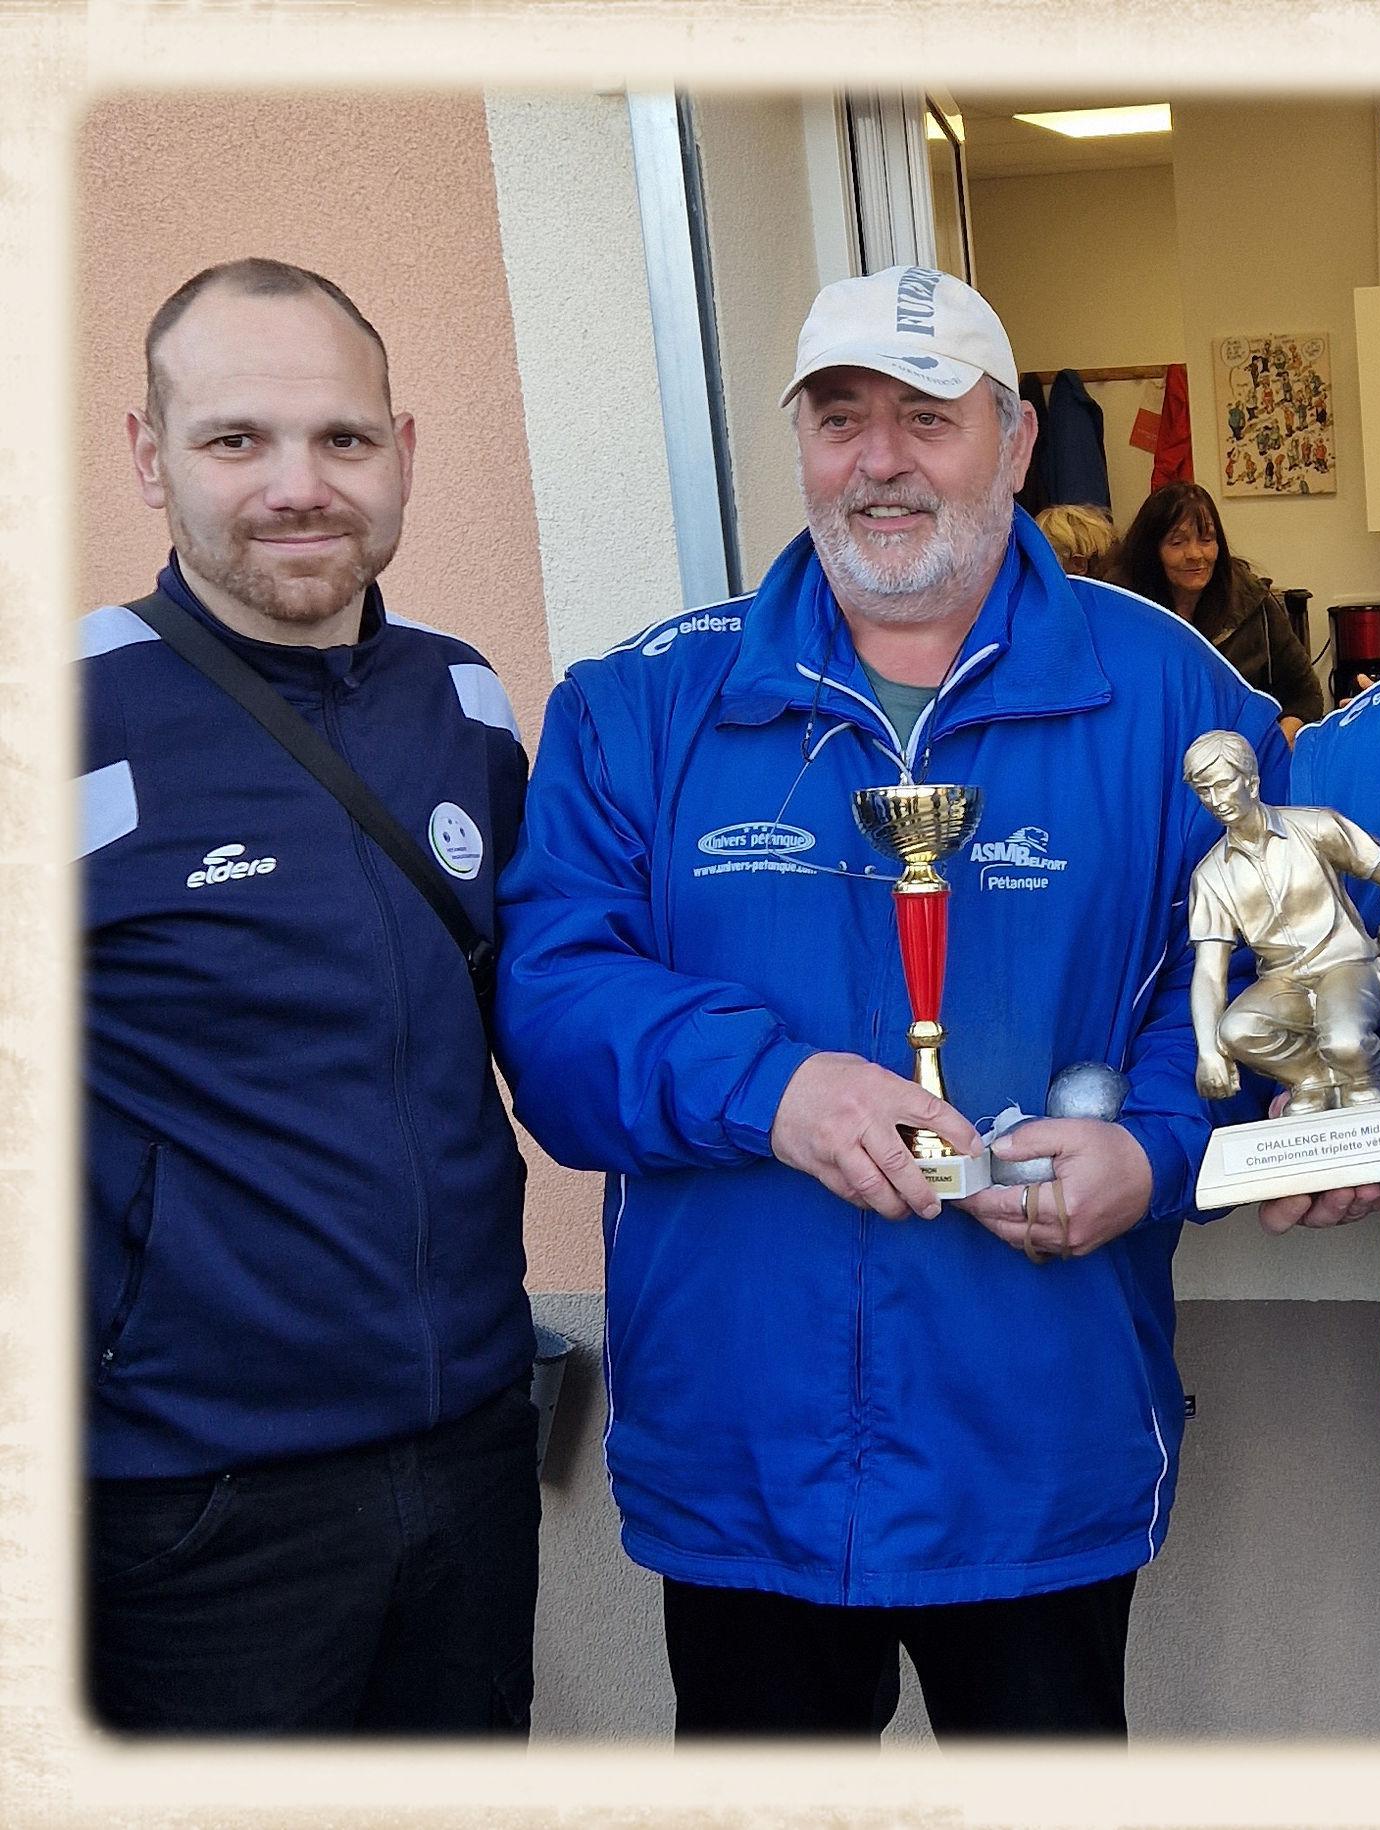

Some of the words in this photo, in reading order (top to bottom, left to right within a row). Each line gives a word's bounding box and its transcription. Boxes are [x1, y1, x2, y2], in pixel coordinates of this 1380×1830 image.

[679, 613, 742, 634] eldera
[186, 857, 277, 889] eldera
[988, 876, 1049, 891] Pétanque
[1256, 1132, 1327, 1152] CHALLENGE
[1329, 1128, 1358, 1141] René
[1246, 1147, 1319, 1167] Championnat
[1321, 1140, 1363, 1155] triplette
